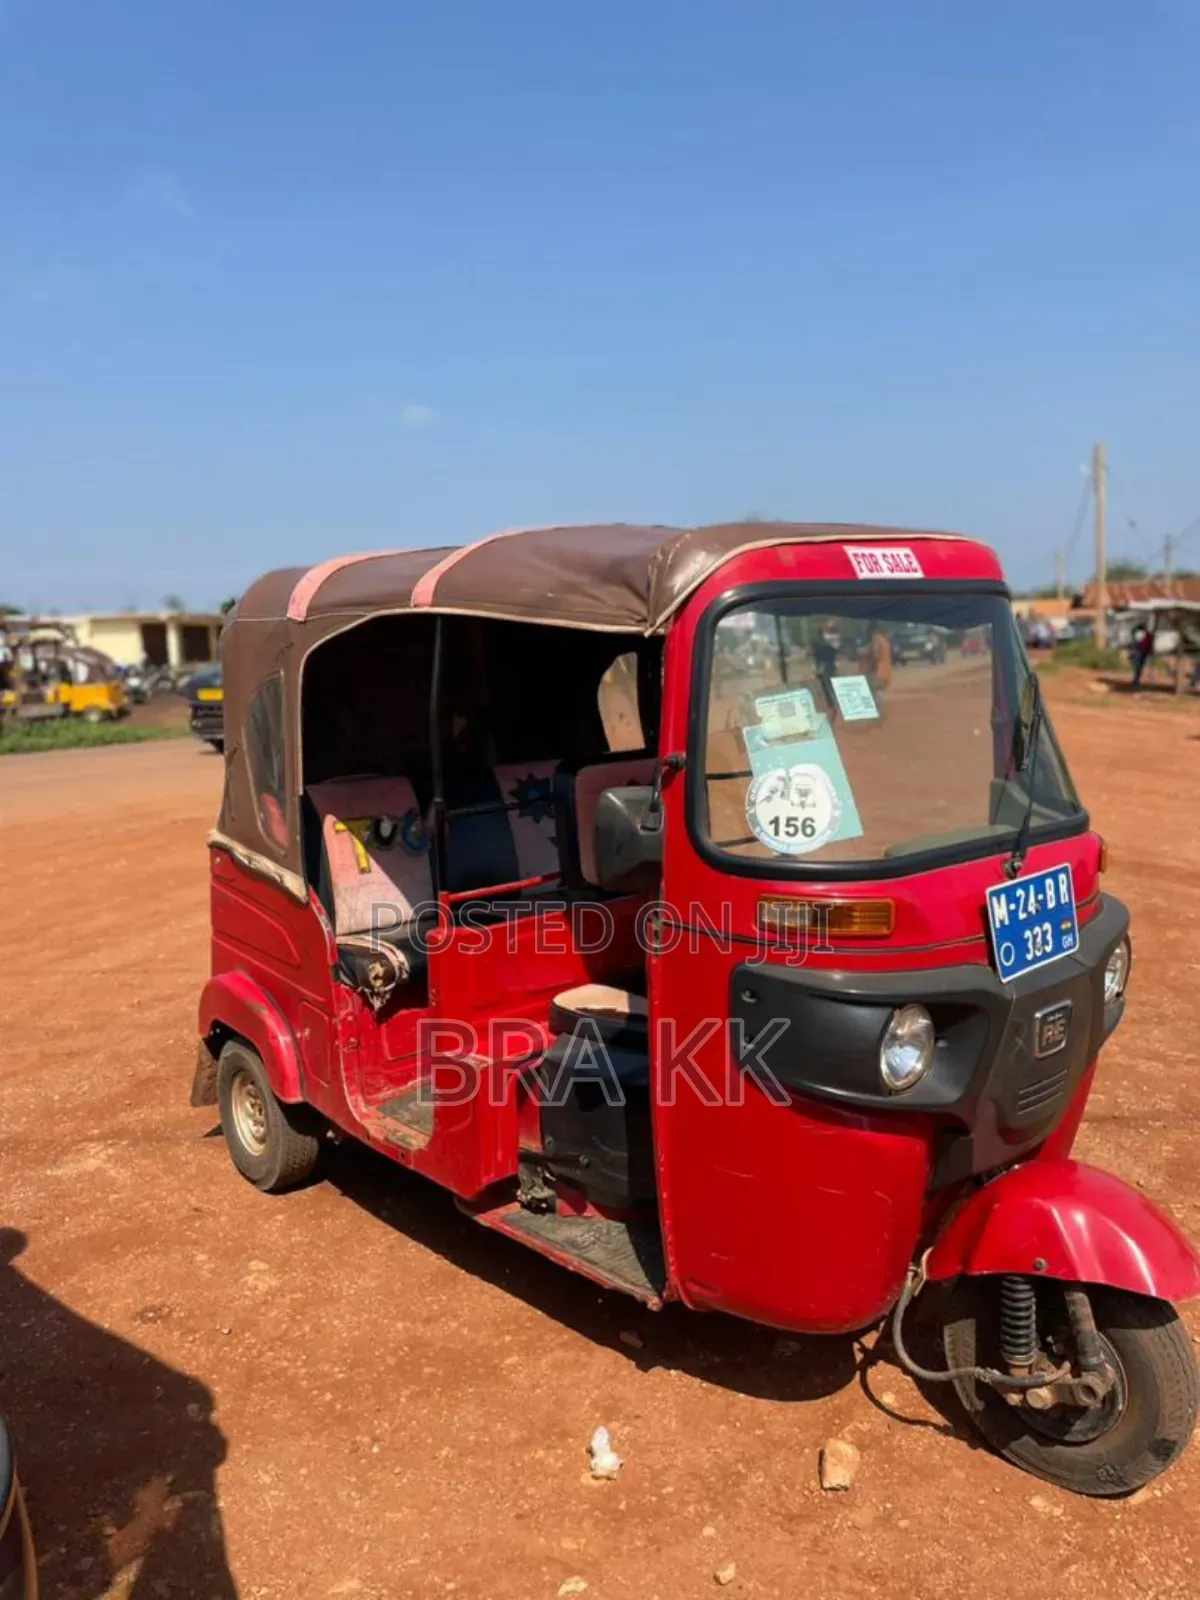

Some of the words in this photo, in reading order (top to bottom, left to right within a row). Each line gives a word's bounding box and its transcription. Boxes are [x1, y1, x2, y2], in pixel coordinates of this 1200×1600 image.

[852, 553, 883, 573] FOR
[882, 552, 918, 574] SALE
[769, 816, 816, 837] 156
[1024, 922, 1053, 961] 333
